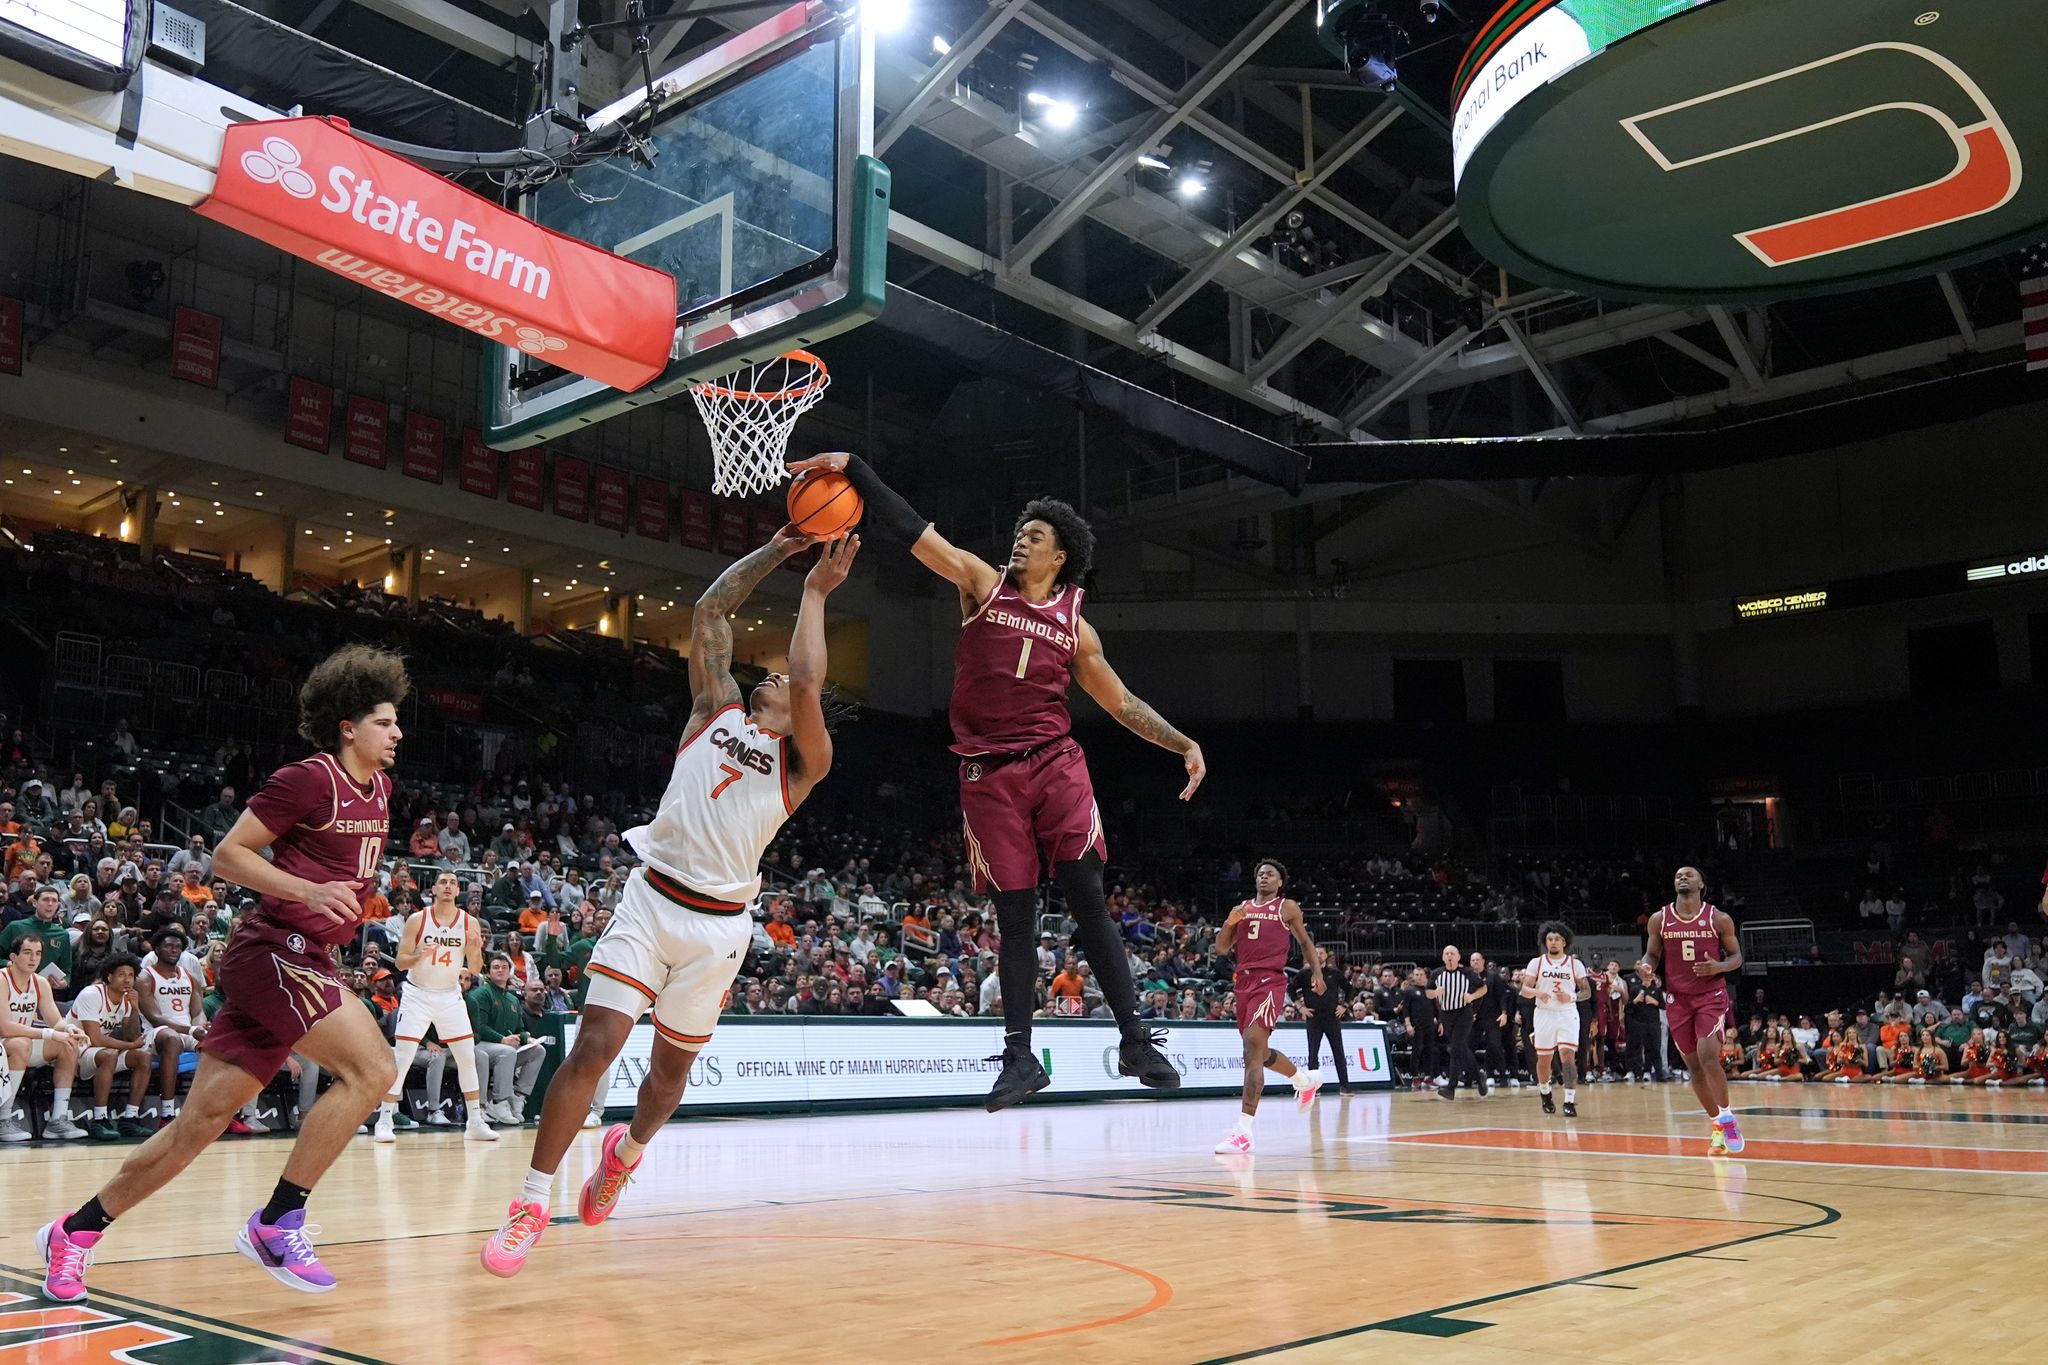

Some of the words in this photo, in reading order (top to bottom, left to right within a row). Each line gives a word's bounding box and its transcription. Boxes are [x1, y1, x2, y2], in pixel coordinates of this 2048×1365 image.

[1453, 79, 1490, 159] ational
[1494, 42, 1548, 92] Bank
[1741, 608, 1773, 617] COOLING
[1775, 605, 1788, 613] THE
[1790, 600, 1826, 611] AMERICAS
[985, 608, 1074, 650] SEMINOLES
[1015, 637, 1034, 679] 1
[709, 727, 775, 776] CANES
[710, 763, 743, 800] 7
[336, 820, 389, 833] SEMINOLE
[356, 836, 382, 879] 10
[1247, 920, 1260, 940] 3
[1663, 930, 1713, 939] SEMINOLES
[423, 935, 462, 947] CANES
[431, 949, 452, 967] 14
[1681, 940, 1696, 961] 6
[1541, 970, 1571, 980] CANES
[158, 987, 191, 996] CANES
[1552, 981, 1562, 993] 3
[9, 1002, 36, 1013] CANES
[171, 998, 184, 1012] 8
[737, 1061, 793, 1077] OFFICIAL
[795, 1060, 827, 1076] WINE
[829, 1060, 845, 1075] OF
[847, 1060, 883, 1074] MIAMI
[885, 1059, 954, 1074] HURRICANES
[956, 1058, 1003, 1072] ATHLETIC
[1194, 1058, 1226, 1070] OFFICIAL
